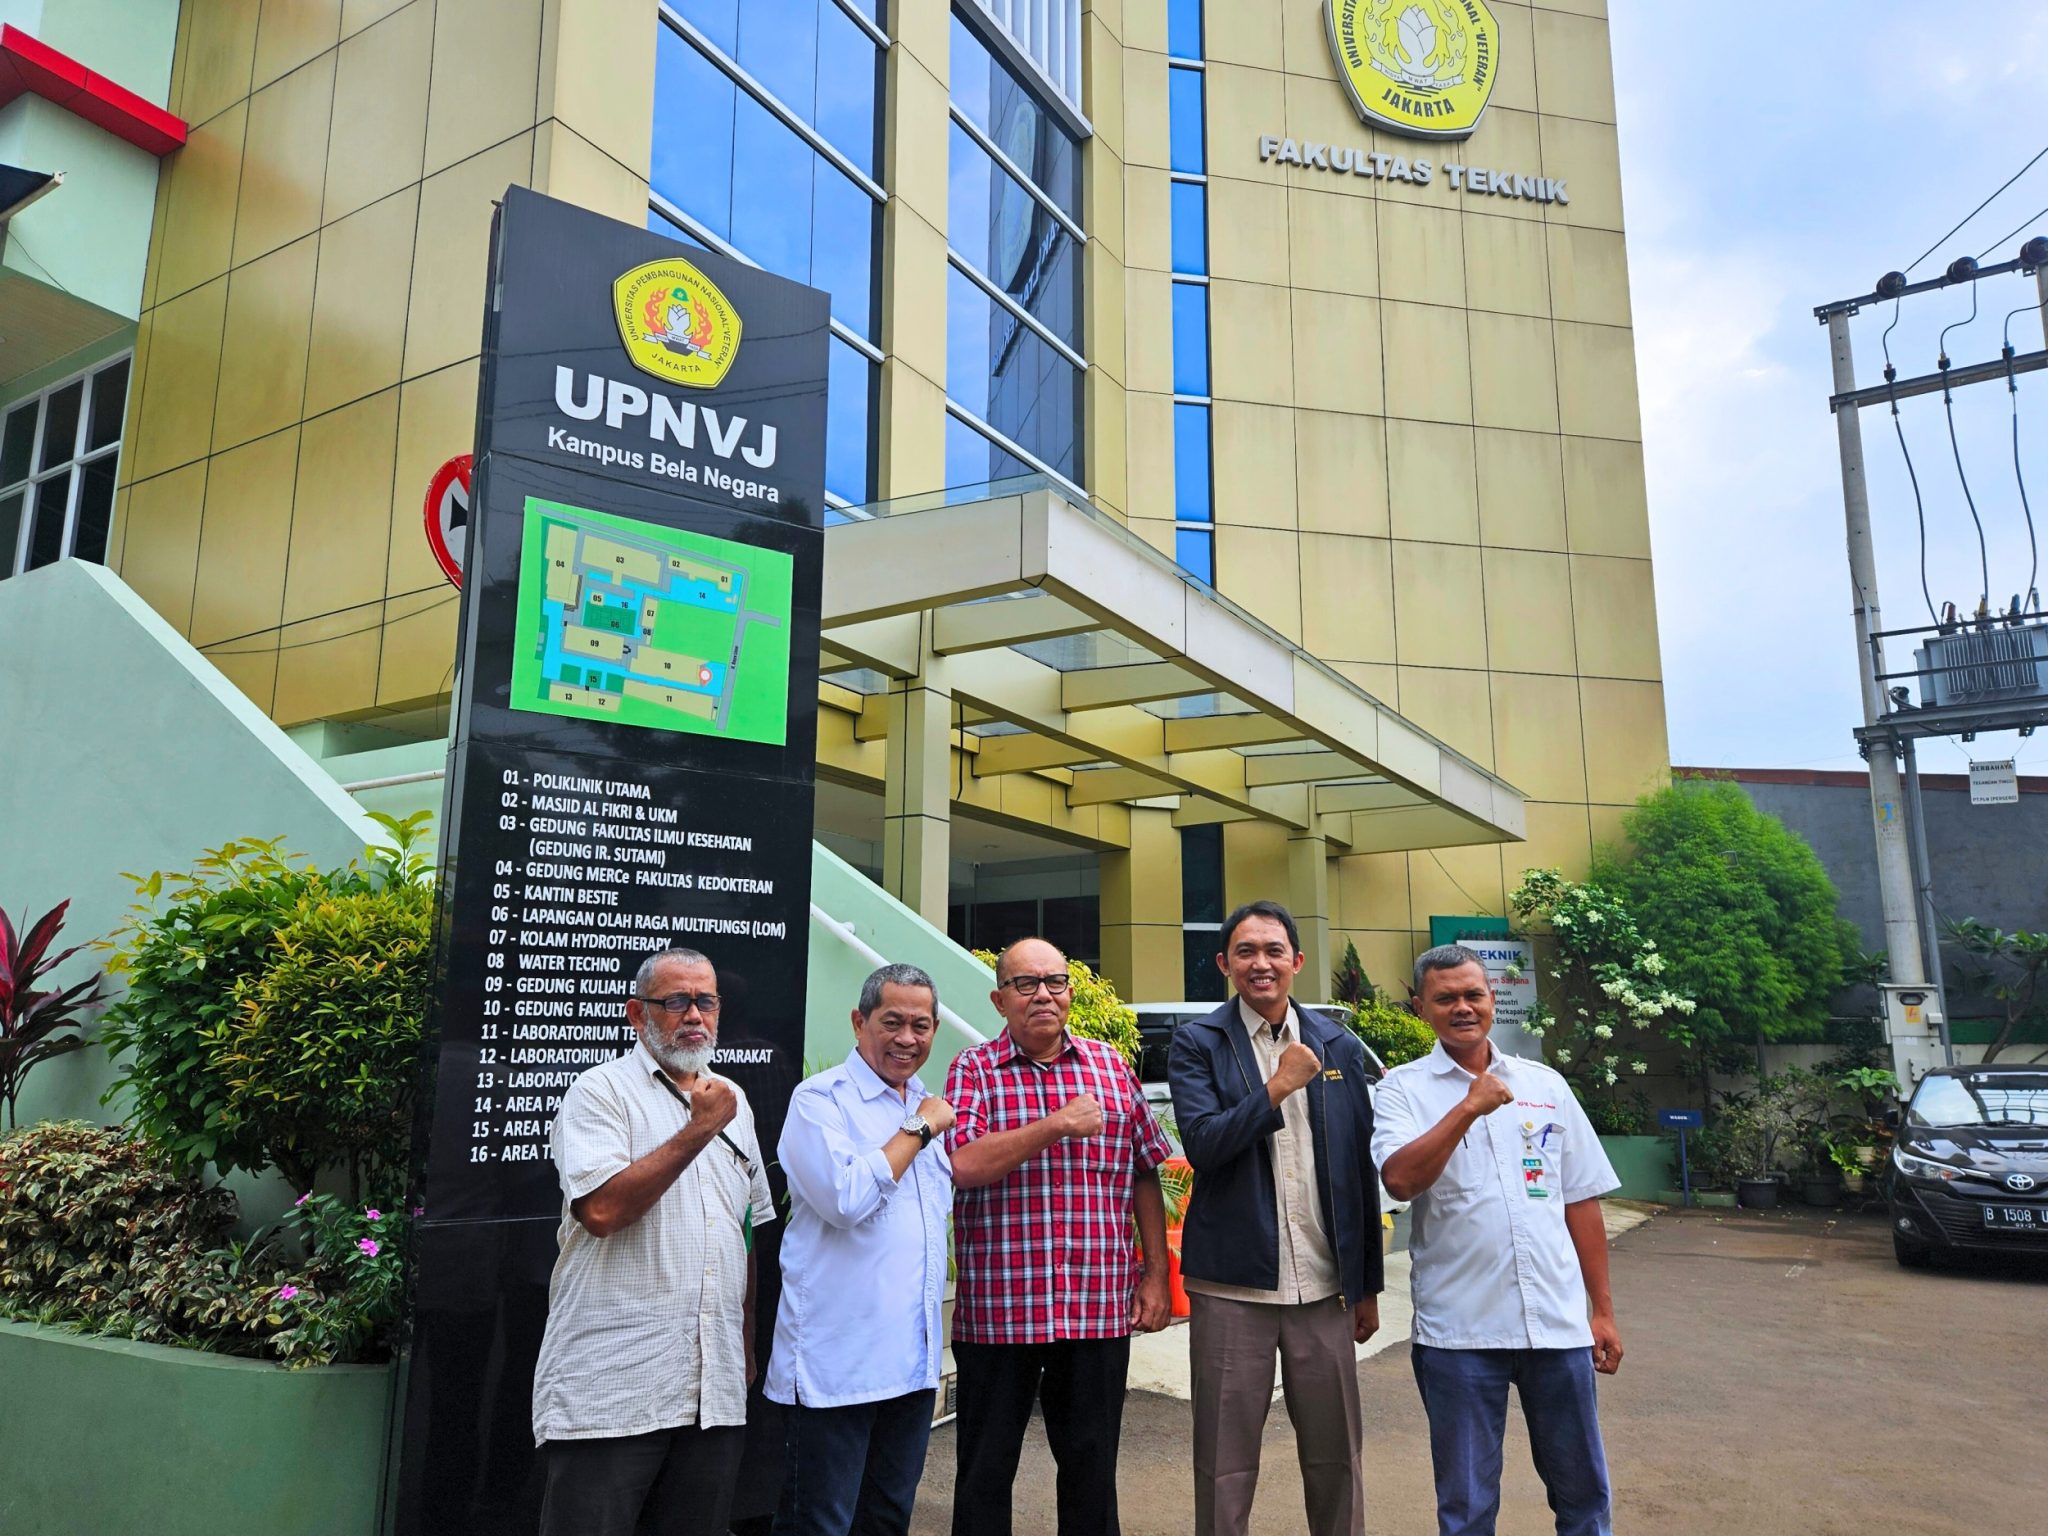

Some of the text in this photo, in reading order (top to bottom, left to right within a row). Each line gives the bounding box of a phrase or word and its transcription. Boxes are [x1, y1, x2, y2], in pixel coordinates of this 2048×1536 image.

[1381, 87, 1455, 118] JAKARTA
[1258, 134, 1571, 205] FAKULTAS TEKNIK
[624, 284, 640, 341] UNIVERSITAS
[637, 269, 700, 288] PEMBANGUNAN
[700, 286, 729, 328] NASIONAL
[651, 353, 702, 373] JAKARTA
[555, 365, 777, 469] UPNVJ
[548, 426, 779, 503] Kampus Bela Negara
[556, 560, 565, 568] 04
[616, 556, 624, 564] 03
[672, 560, 680, 568] 02
[721, 575, 728, 583] 01
[593, 594, 602, 603] 05
[647, 609, 654, 617] 07
[590, 639, 599, 648] 09
[664, 662, 671, 670] 10
[590, 675, 597, 683] 15
[565, 693, 572, 701] 13
[503, 770, 519, 785] 01
[533, 773, 603, 794] POLIKLINIK
[606, 781, 651, 799] UTAMA
[502, 792, 518, 807] 02
[532, 795, 580, 813] MASJID
[583, 800, 599, 816] AL
[602, 802, 632, 819] FIKRI
[635, 806, 645, 820] &
[649, 807, 677, 823] UKM
[500, 815, 516, 830] 03
[530, 817, 586, 836] GEDUNG
[593, 823, 651, 842] FAKULTAS
[654, 829, 684, 845] ILMU
[687, 832, 751, 851] KESEHATAN
[530, 838, 665, 868] (GEDUNG IR. SUTAMI)
[496, 860, 512, 875] 04
[526, 862, 583, 880] GEDUNG
[586, 867, 629, 883] MERCe
[636, 871, 692, 888] FAKULTAS
[698, 876, 773, 894] KEDOKTERAN
[494, 884, 510, 899] 05
[525, 885, 574, 902] KANTIN
[578, 889, 618, 906] BESTIE
[492, 906, 508, 921] 06
[523, 908, 594, 926] LAPANGAN
[597, 913, 632, 928] OLAH
[635, 914, 669, 930] RAGA
[672, 917, 750, 935] MULTIFUNGSI
[752, 921, 785, 939] (LOM)
[490, 929, 506, 944] 07
[520, 931, 568, 947] KOLAM
[572, 933, 673, 953] HYDROTHERAPY
[487, 953, 620, 972] 08 WATER TECHNO
[1478, 950, 1522, 960] EKNIK
[485, 976, 502, 992] 09
[517, 977, 575, 994] GEDUNG
[580, 979, 626, 995] KULIAH
[484, 1000, 500, 1015] 10
[515, 1000, 573, 1017] GEDUNG
[1496, 1008, 1529, 1017] Perkapala
[481, 1024, 497, 1039] 11
[513, 1024, 619, 1040] LABORATORIUM
[479, 1049, 496, 1063] 12
[510, 1049, 616, 1063] LABORATORIUM
[710, 1049, 773, 1064] ASYARAKAT
[477, 1073, 494, 1088] 13
[508, 1072, 580, 1088] LABORATO
[475, 1097, 491, 1113] 14
[505, 1096, 542, 1112] AREA
[472, 1121, 489, 1137] 15
[503, 1120, 540, 1136] AREA
[470, 1146, 488, 1162] 16
[501, 1144, 538, 1161] AREA
[1986, 1207, 1994, 1220] B
[2004, 1208, 2032, 1222] 1508
